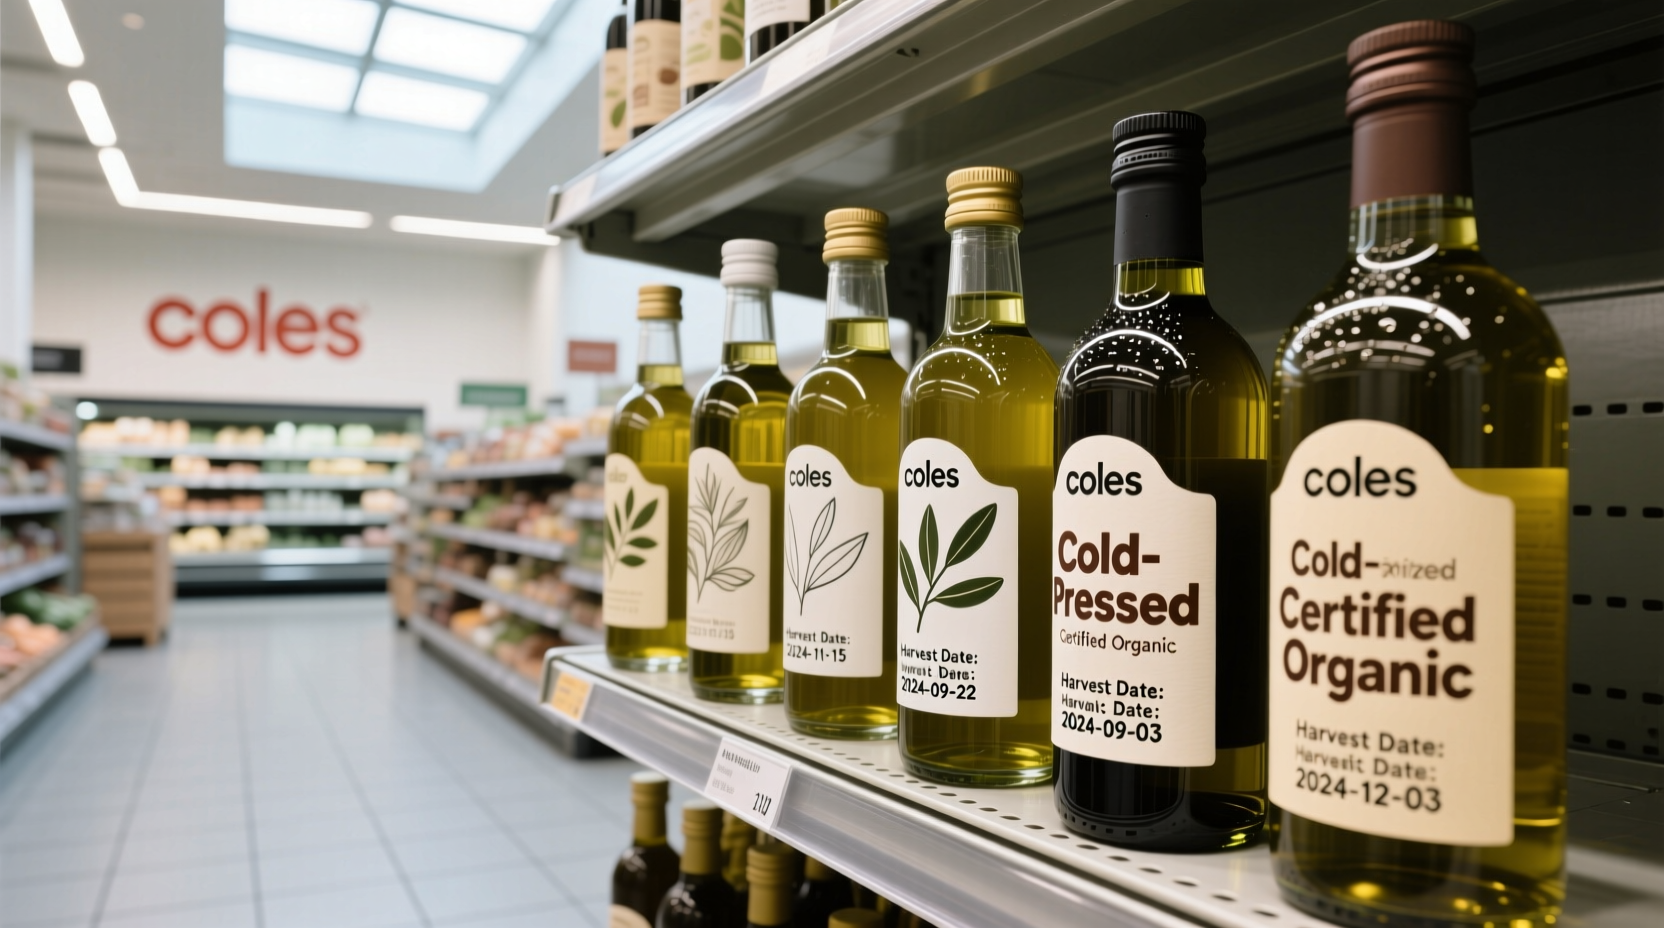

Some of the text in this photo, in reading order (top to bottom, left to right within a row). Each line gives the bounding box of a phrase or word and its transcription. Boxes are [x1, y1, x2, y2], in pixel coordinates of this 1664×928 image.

[147, 284, 362, 358] coles
[789, 463, 832, 488] coles
[905, 459, 960, 488] coles
[1066, 461, 1143, 496] coles
[1304, 456, 1417, 497] coles
[1058, 530, 1160, 576] Cold-
[1054, 576, 1200, 626] Pressed
[1280, 586, 1475, 642] Certified
[901, 643, 978, 664] Harvest Date:
[1112, 634, 1178, 657] Organic
[1061, 672, 1164, 700] Harvest Date:
[1283, 638, 1474, 703] Organic
[1061, 711, 1163, 743] 2024-09-03
[1113, 701, 1160, 719] Date:
[1297, 718, 1445, 759] Harvest Date:
[1373, 757, 1438, 782] Date:
[1296, 767, 1442, 813] 2024-12-03
